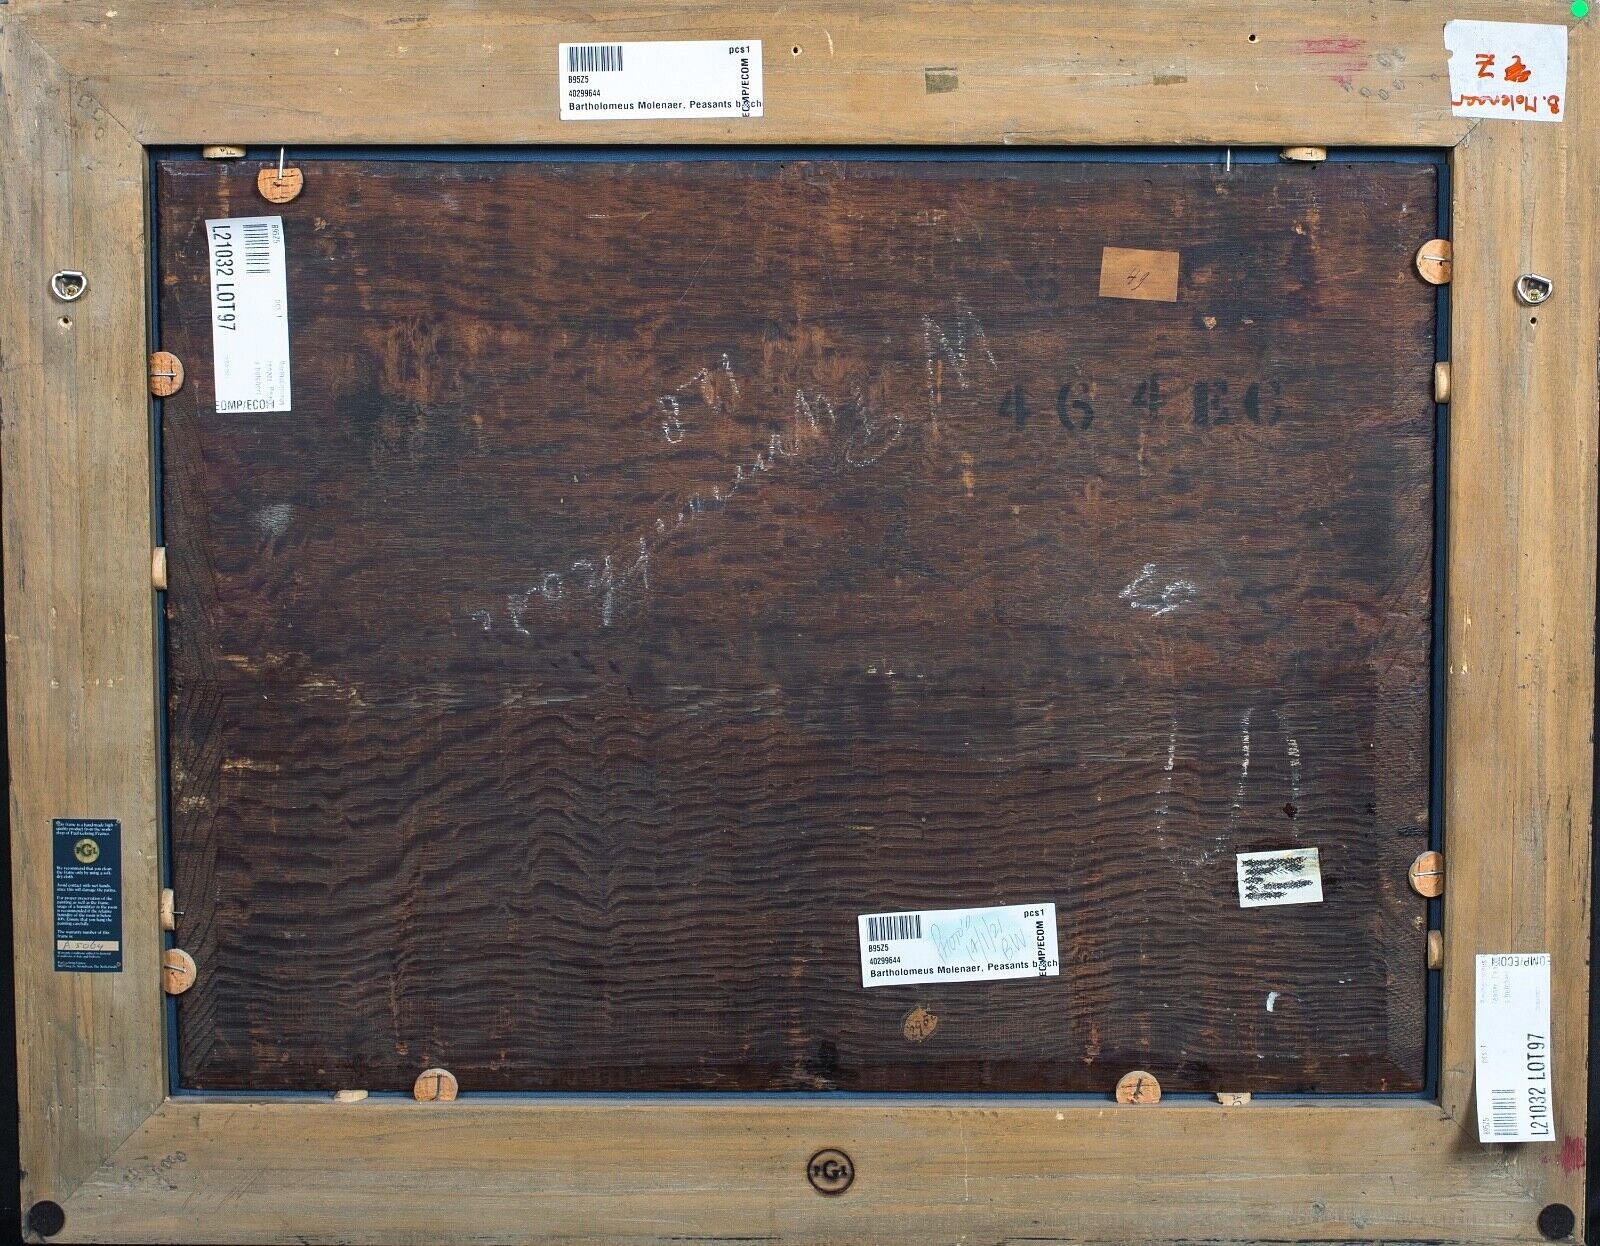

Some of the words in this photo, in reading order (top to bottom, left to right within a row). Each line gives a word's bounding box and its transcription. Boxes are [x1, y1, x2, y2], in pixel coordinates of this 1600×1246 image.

[568, 89, 601, 98] 40299644
[569, 101, 634, 111] Bartholomeus
[689, 100, 732, 109] Peasants
[212, 225, 234, 276] L21032
[869, 956, 901, 966] 40299644
[870, 966, 934, 978] Bartholomeus
[987, 961, 1029, 971] Peasants
[1528, 1087, 1549, 1135] L21032
